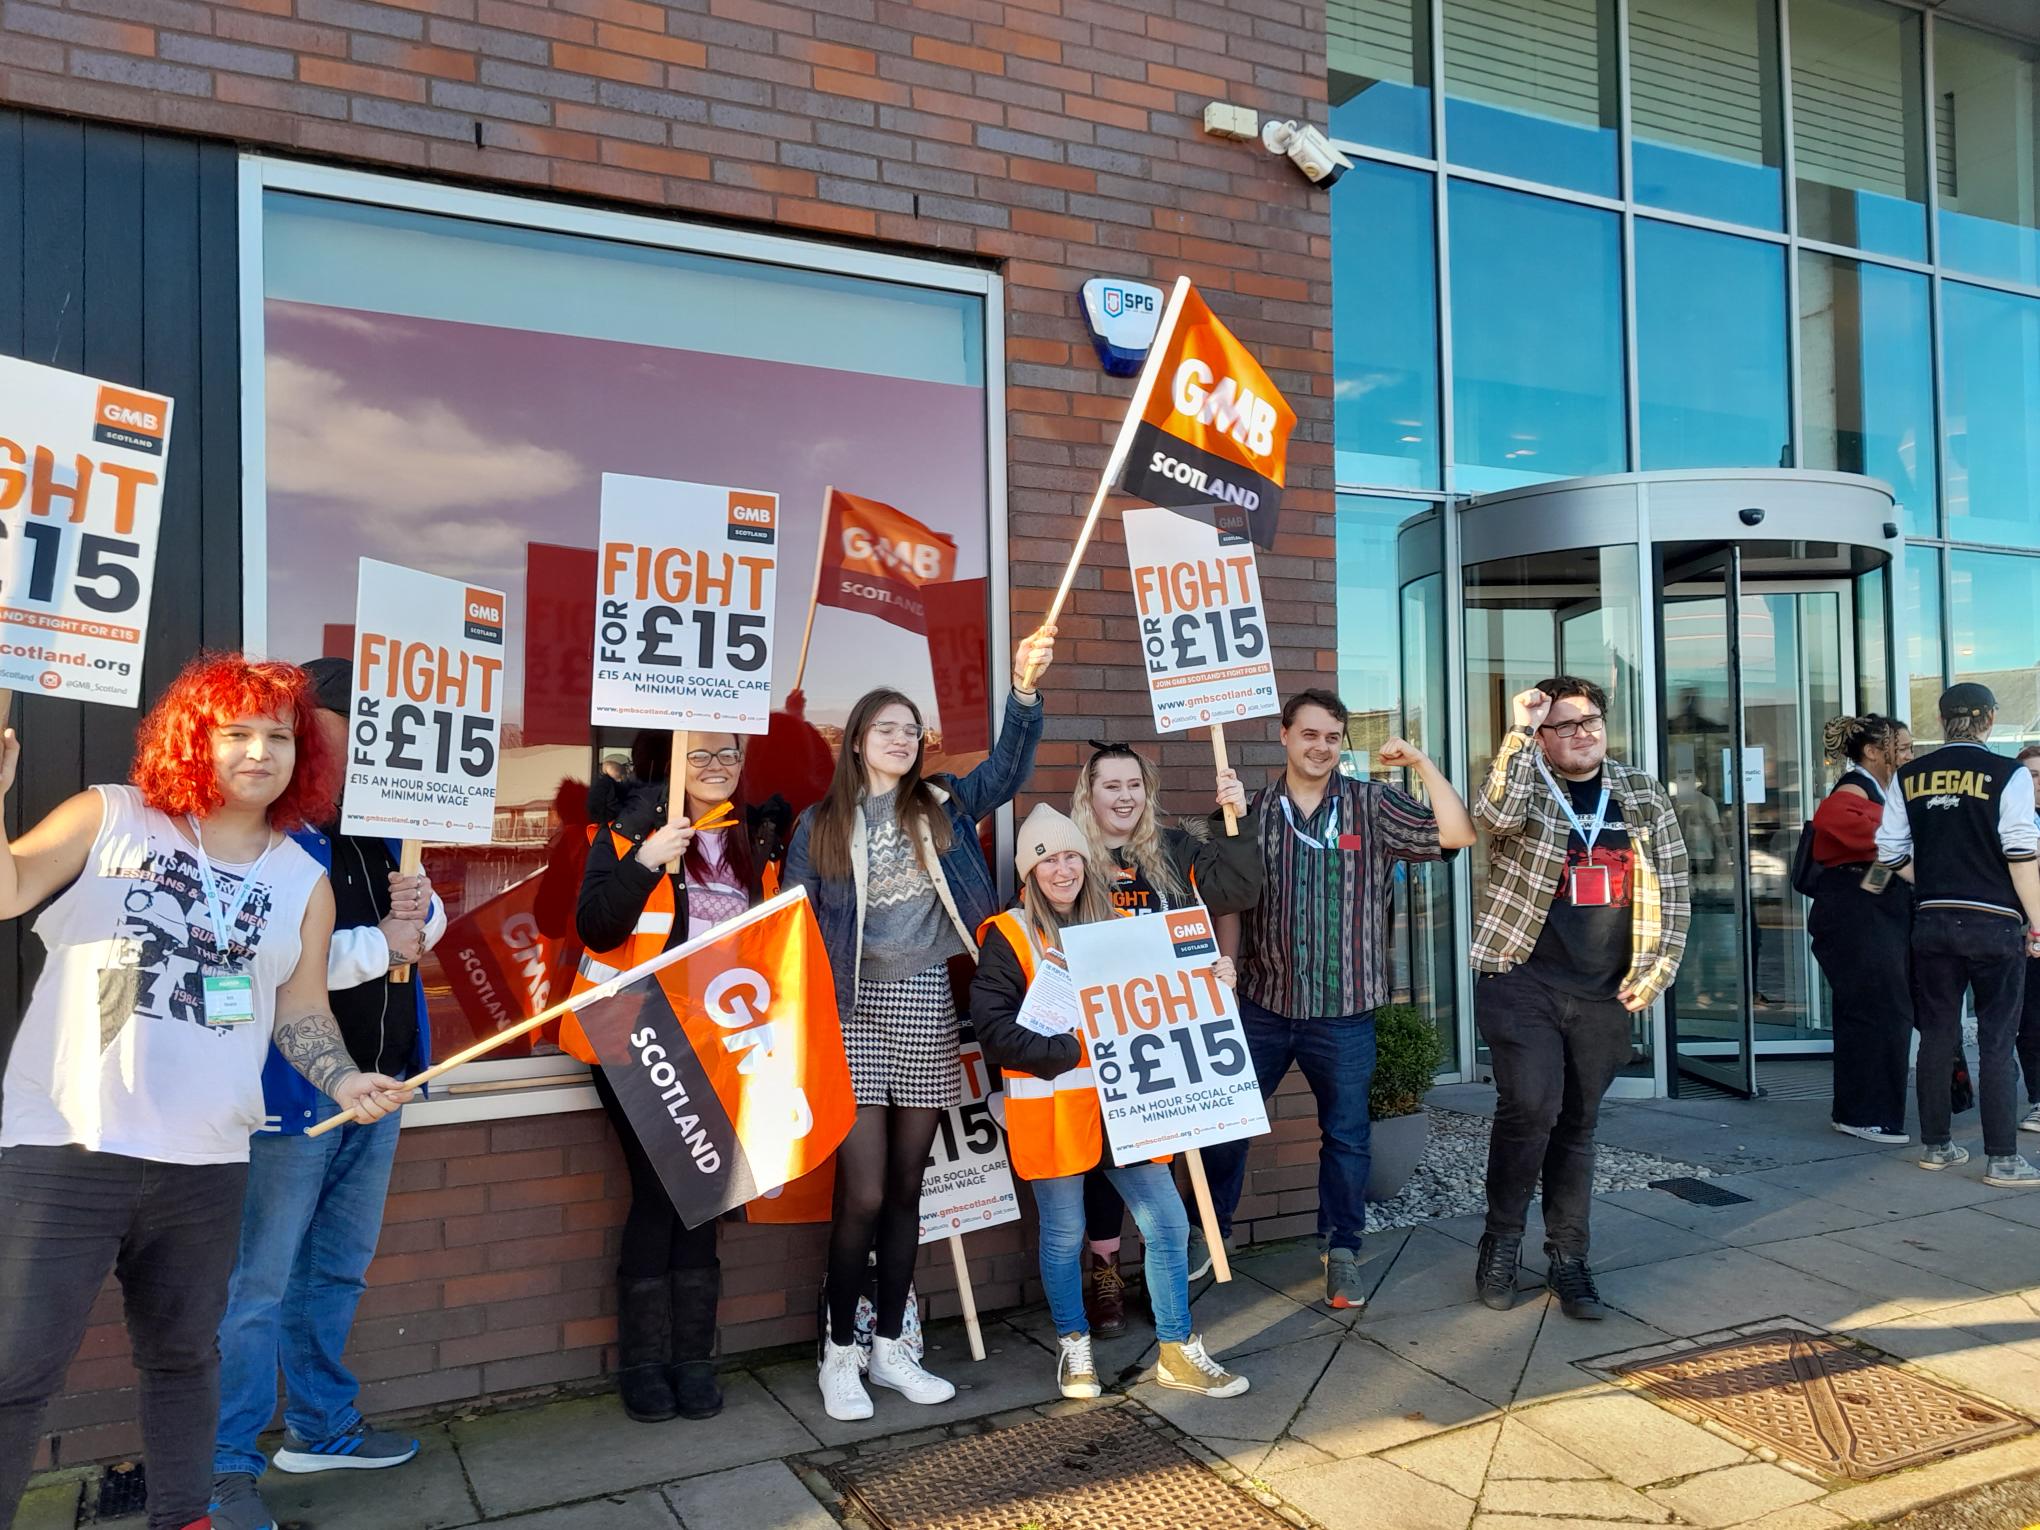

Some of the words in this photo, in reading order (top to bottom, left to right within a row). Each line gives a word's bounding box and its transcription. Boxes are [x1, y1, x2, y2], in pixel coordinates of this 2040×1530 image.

[1125, 293, 1153, 311] SPG
[104, 403, 158, 431] GMB
[1172, 358, 1277, 457] GMB
[106, 431, 153, 448] SCOTLAND
[0, 436, 158, 535] GHT
[1149, 452, 1260, 511] SCOTLAND
[733, 506, 771, 523] GMB
[735, 529, 767, 538] SCOTLAND
[0, 519, 141, 614] 15
[842, 527, 941, 579] GMB
[603, 542, 775, 611] FIGHT
[1135, 555, 1253, 615] FIGHT
[469, 602, 499, 622] GMB
[40, 616, 79, 632] FIGHT
[81, 623, 107, 636] FOR
[110, 628, 134, 641] £15
[470, 627, 497, 638] SCOTLAND
[600, 600, 629, 663] FOR
[636, 605, 767, 672] £15
[1143, 617, 1168, 673] FOR
[1170, 606, 1264, 669] £15
[0, 643, 131, 676] cotland.org
[359, 632, 502, 713] FIGHT
[597, 670, 619, 680] £15
[622, 671, 642, 682] AN
[646, 673, 684, 685] HOUR
[688, 676, 734, 688] SOCIAL
[738, 680, 771, 691] CARE
[635, 683, 697, 697] MINIMUM
[701, 687, 739, 699] WAGE
[1155, 679, 1172, 688] JOIN
[1173, 677, 1187, 686] GMB
[1226, 669, 1244, 678] FIGHT
[1245, 667, 1257, 675] FOR
[596, 705, 683, 718] www.gmbscotland.org
[1157, 686, 1273, 711] www.gmbscotland.org
[354, 696, 381, 766] FOR
[385, 704, 495, 777] £15
[350, 773, 369, 785] £15
[371, 776, 388, 787] AN
[391, 778, 424, 790] HOUR
[427, 781, 465, 795] SOCIAL
[468, 786, 496, 798] CARE
[381, 788, 433, 803] MINIMUM
[437, 793, 469, 807] WAGE
[1904, 770, 1989, 801] ILLEGAL
[347, 813, 420, 826] www.gmbscotland.org
[112, 867, 186, 893] LESBIANS
[188, 888, 199, 899] &
[238, 911, 267, 930] MEN
[1107, 890, 1150, 907] IGHT
[190, 926, 253, 957] SUPORT
[1173, 922, 1206, 938] GMB
[195, 945, 219, 963] THE
[1180, 942, 1209, 953] SCOTLAND
[458, 948, 513, 1033] SCOTLAN
[1079, 966, 1226, 1039] FIGHT
[1093, 1040, 1128, 1103] FOR
[1129, 1018, 1246, 1095] £15
[630, 1026, 721, 1173] SCOTLAND
[1108, 1107, 1127, 1120] £15
[1129, 1104, 1146, 1116] AN
[1150, 1096, 1183, 1111] HOUR
[1185, 1087, 1226, 1103] SOCIAL
[1229, 1080, 1259, 1094] CARE
[1142, 1104, 1197, 1124] MINIMUM
[1199, 1096, 1235, 1112] WAGE
[922, 1103, 998, 1167] 15
[1116, 1130, 1192, 1151] www.gmbscotland.org
[919, 1183, 953, 1198] NIMUM
[955, 1174, 986, 1189] WAGE
[920, 1175, 941, 1188] OUR
[943, 1167, 980, 1182] SOCIAL
[981, 1159, 1008, 1173] CARE
